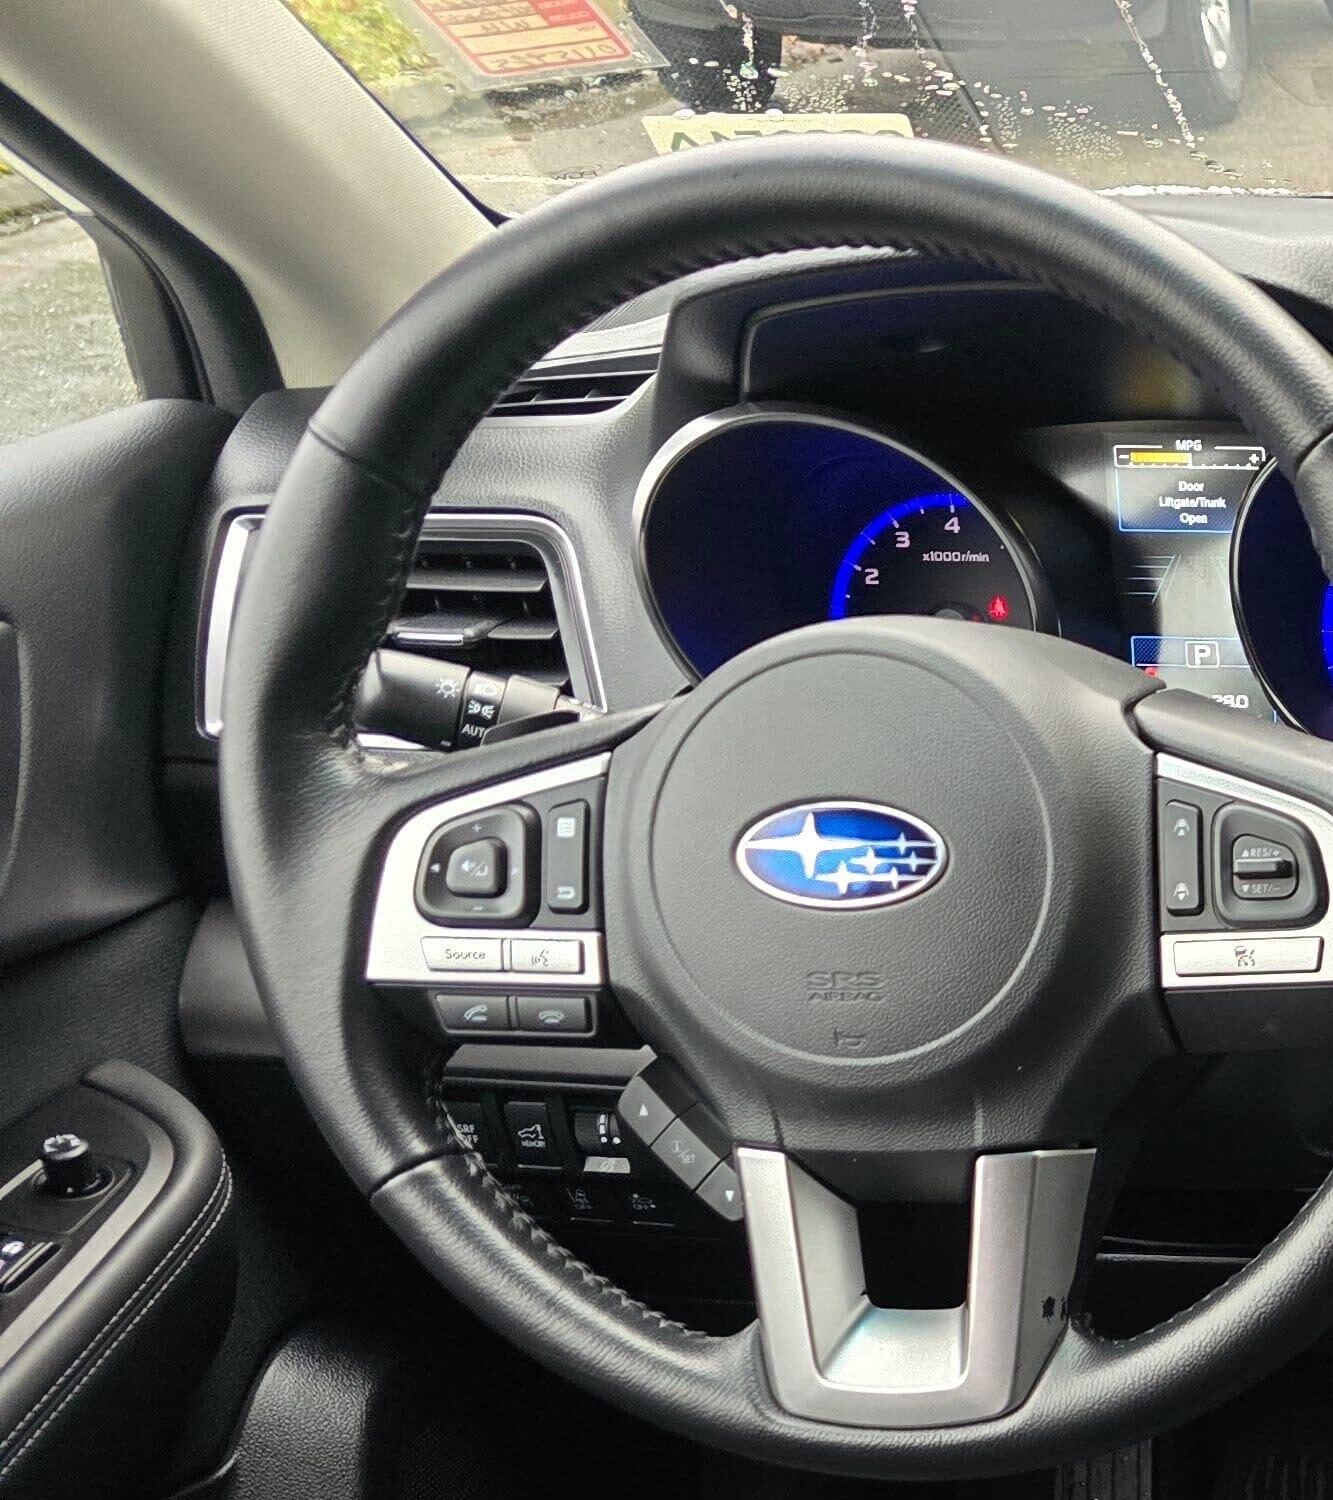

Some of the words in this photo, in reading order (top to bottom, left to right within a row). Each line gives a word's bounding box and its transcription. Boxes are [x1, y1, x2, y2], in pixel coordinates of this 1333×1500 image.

[1175, 439, 1202, 451] MPG
[1178, 480, 1204, 492] Door
[1158, 496, 1226, 509] Liftgate/Trunk
[944, 517, 960, 534] 4
[1179, 512, 1208, 525] Open
[895, 532, 910, 547] 3
[864, 568, 880, 584] 2
[1194, 644, 1211, 666] P
[461, 723, 486, 738] AUT
[444, 947, 487, 961] Source
[806, 970, 883, 990] SRS
